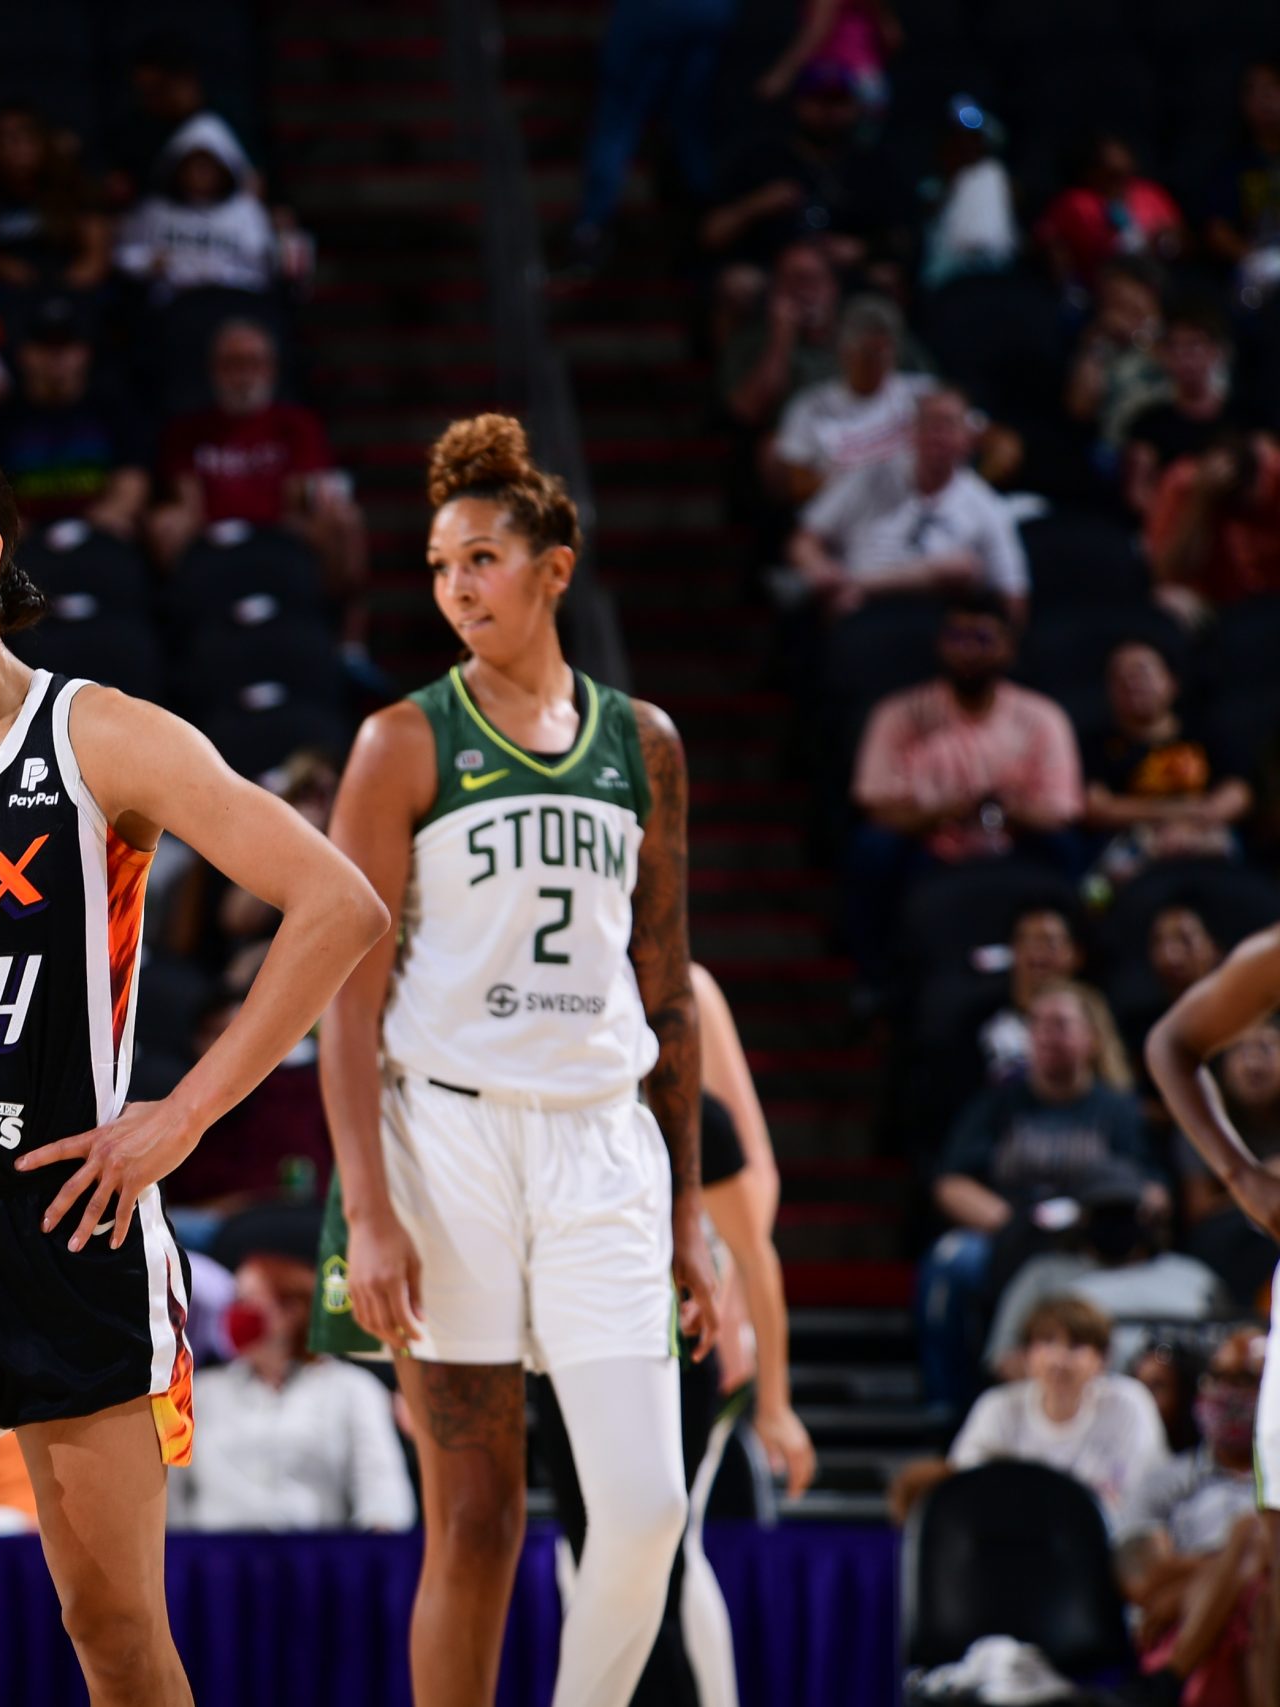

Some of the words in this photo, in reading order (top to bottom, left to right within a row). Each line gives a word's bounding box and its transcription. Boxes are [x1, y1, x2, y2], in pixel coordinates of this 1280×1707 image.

[8, 792, 60, 809] PayPal
[468, 806, 627, 892] STORM
[533, 887, 574, 964] 2
[525, 991, 607, 1015] SWEDIS
